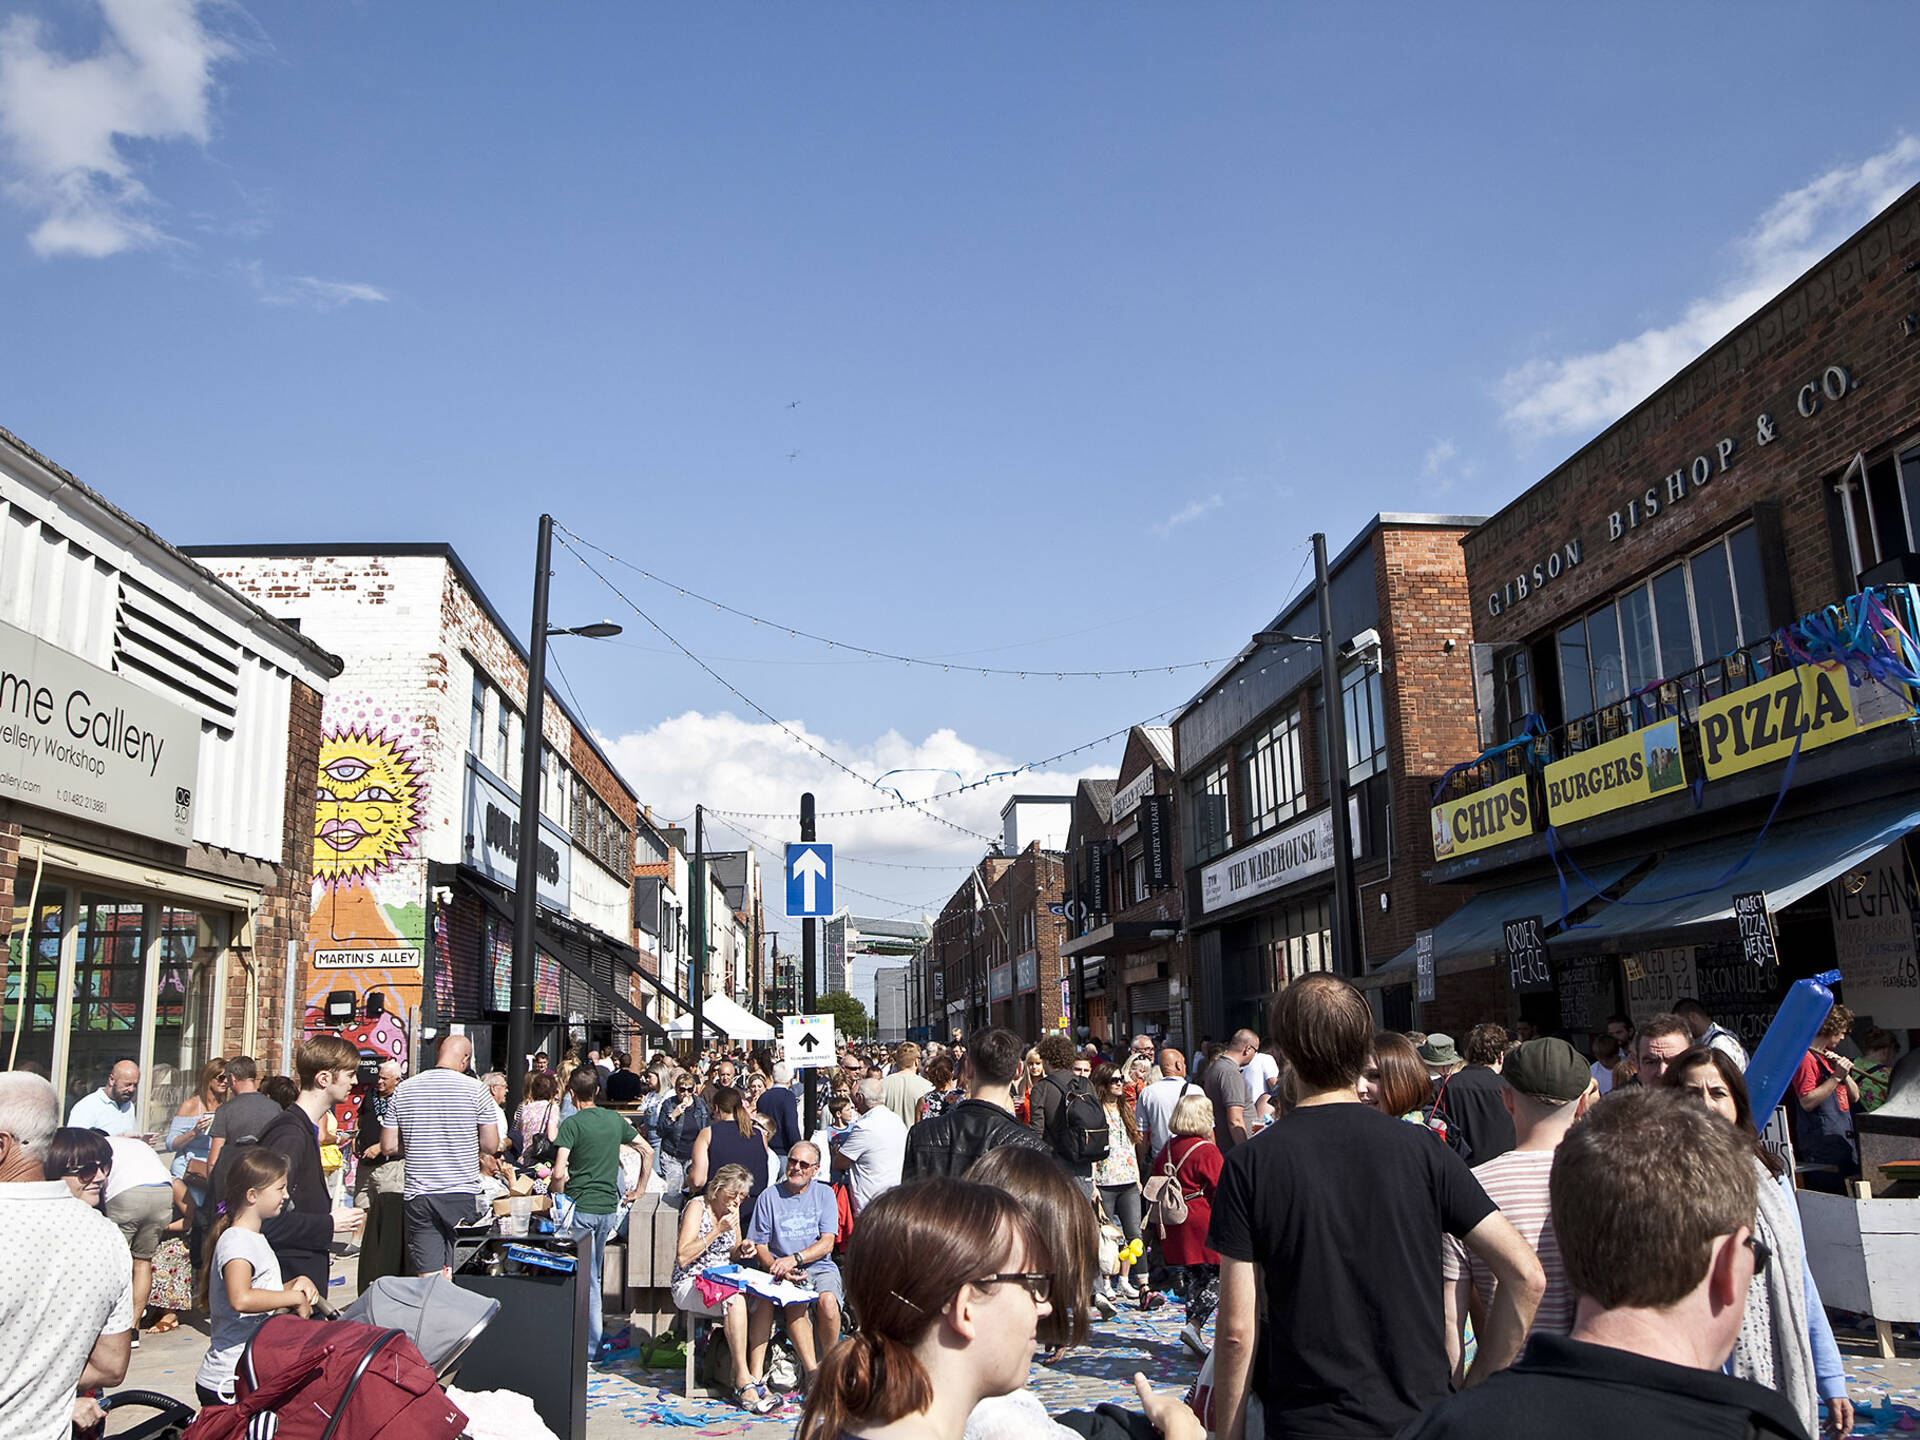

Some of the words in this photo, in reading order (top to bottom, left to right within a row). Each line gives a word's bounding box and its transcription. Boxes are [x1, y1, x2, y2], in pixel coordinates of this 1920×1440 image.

[1488, 537, 1584, 617] GIBSON
[1607, 437, 1735, 543] BISHOP
[1756, 413, 1778, 447] &
[1797, 365, 1862, 418] CO.
[66, 690, 164, 777] Gallery
[1702, 672, 1849, 765] PIZZA
[45, 736, 106, 778] Workshop
[1549, 752, 1645, 809] BURGERS
[1150, 799, 1160, 835] WHARF
[1452, 787, 1527, 844] CHIPS
[1152, 835, 1162, 879] BREWERY
[1227, 860, 1248, 892] THE
[1248, 829, 1317, 883] WAREHOUSE
[1735, 895, 1763, 913] COLLECT
[1828, 866, 1911, 920] VEGAN
[1506, 920, 1542, 953] ORDER
[1738, 912, 1769, 938] PIZZA
[319, 953, 375, 964] MARTIN'S
[380, 952, 415, 963] ALLEY
[1509, 949, 1546, 989] HERE
[1743, 936, 1775, 961] HERE
[1630, 975, 1673, 1001] LOADED
[1697, 966, 1736, 995] BACON
[1737, 965, 1767, 993] BLUE
